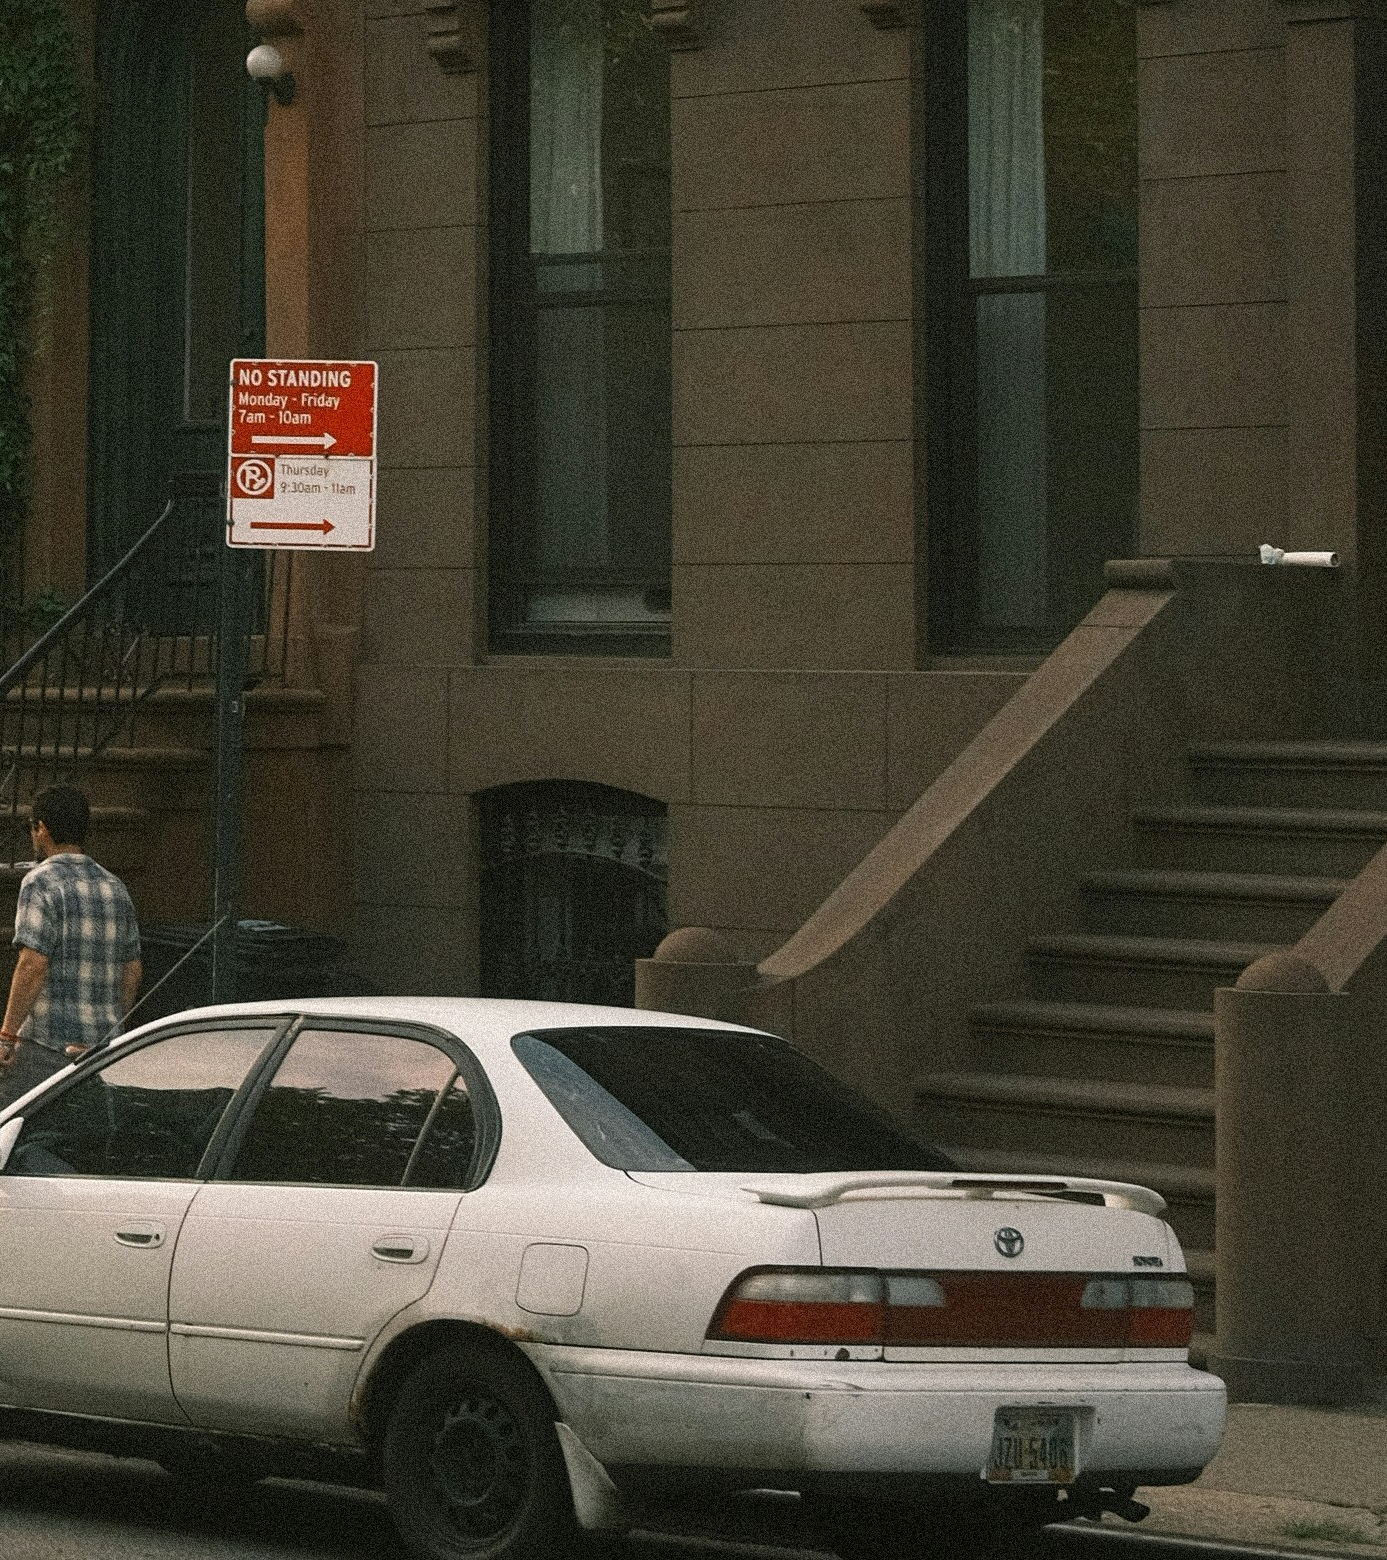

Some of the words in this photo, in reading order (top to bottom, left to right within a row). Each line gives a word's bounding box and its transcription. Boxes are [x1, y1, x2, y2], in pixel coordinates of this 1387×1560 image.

[238, 369, 263, 386] NO
[267, 369, 352, 388] STANDING
[238, 392, 288, 409] Monday
[301, 393, 340, 410] Friday
[238, 410, 266, 424] 7am
[279, 411, 312, 425] 10am
[280, 464, 330, 478] Thursday
[280, 482, 321, 494] 9:30am
[331, 482, 357, 495] 11am
